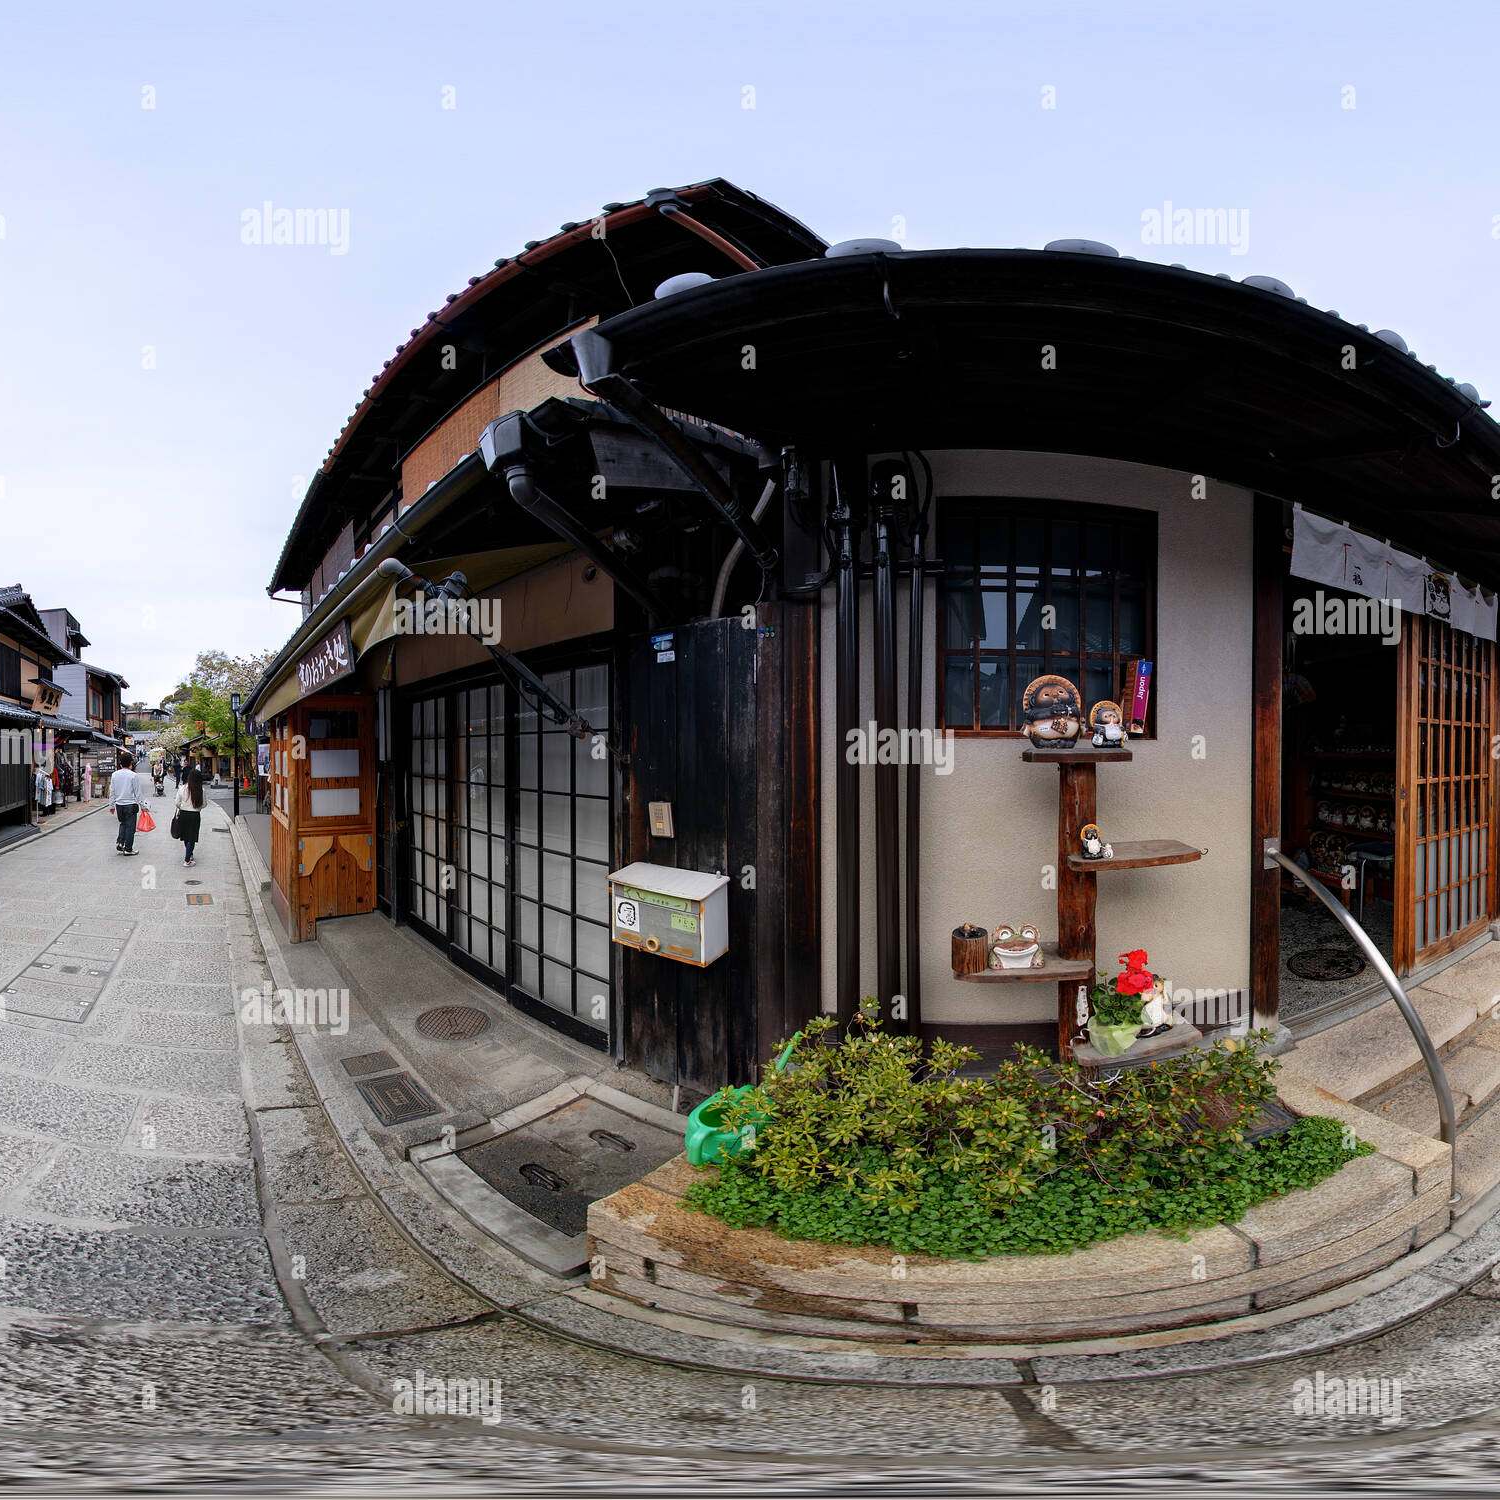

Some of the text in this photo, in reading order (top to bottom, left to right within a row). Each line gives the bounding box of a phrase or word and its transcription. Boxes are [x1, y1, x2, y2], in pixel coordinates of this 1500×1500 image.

[299, 634, 348, 694] 京のおかき処
[1137, 676, 1146, 700] Japon
